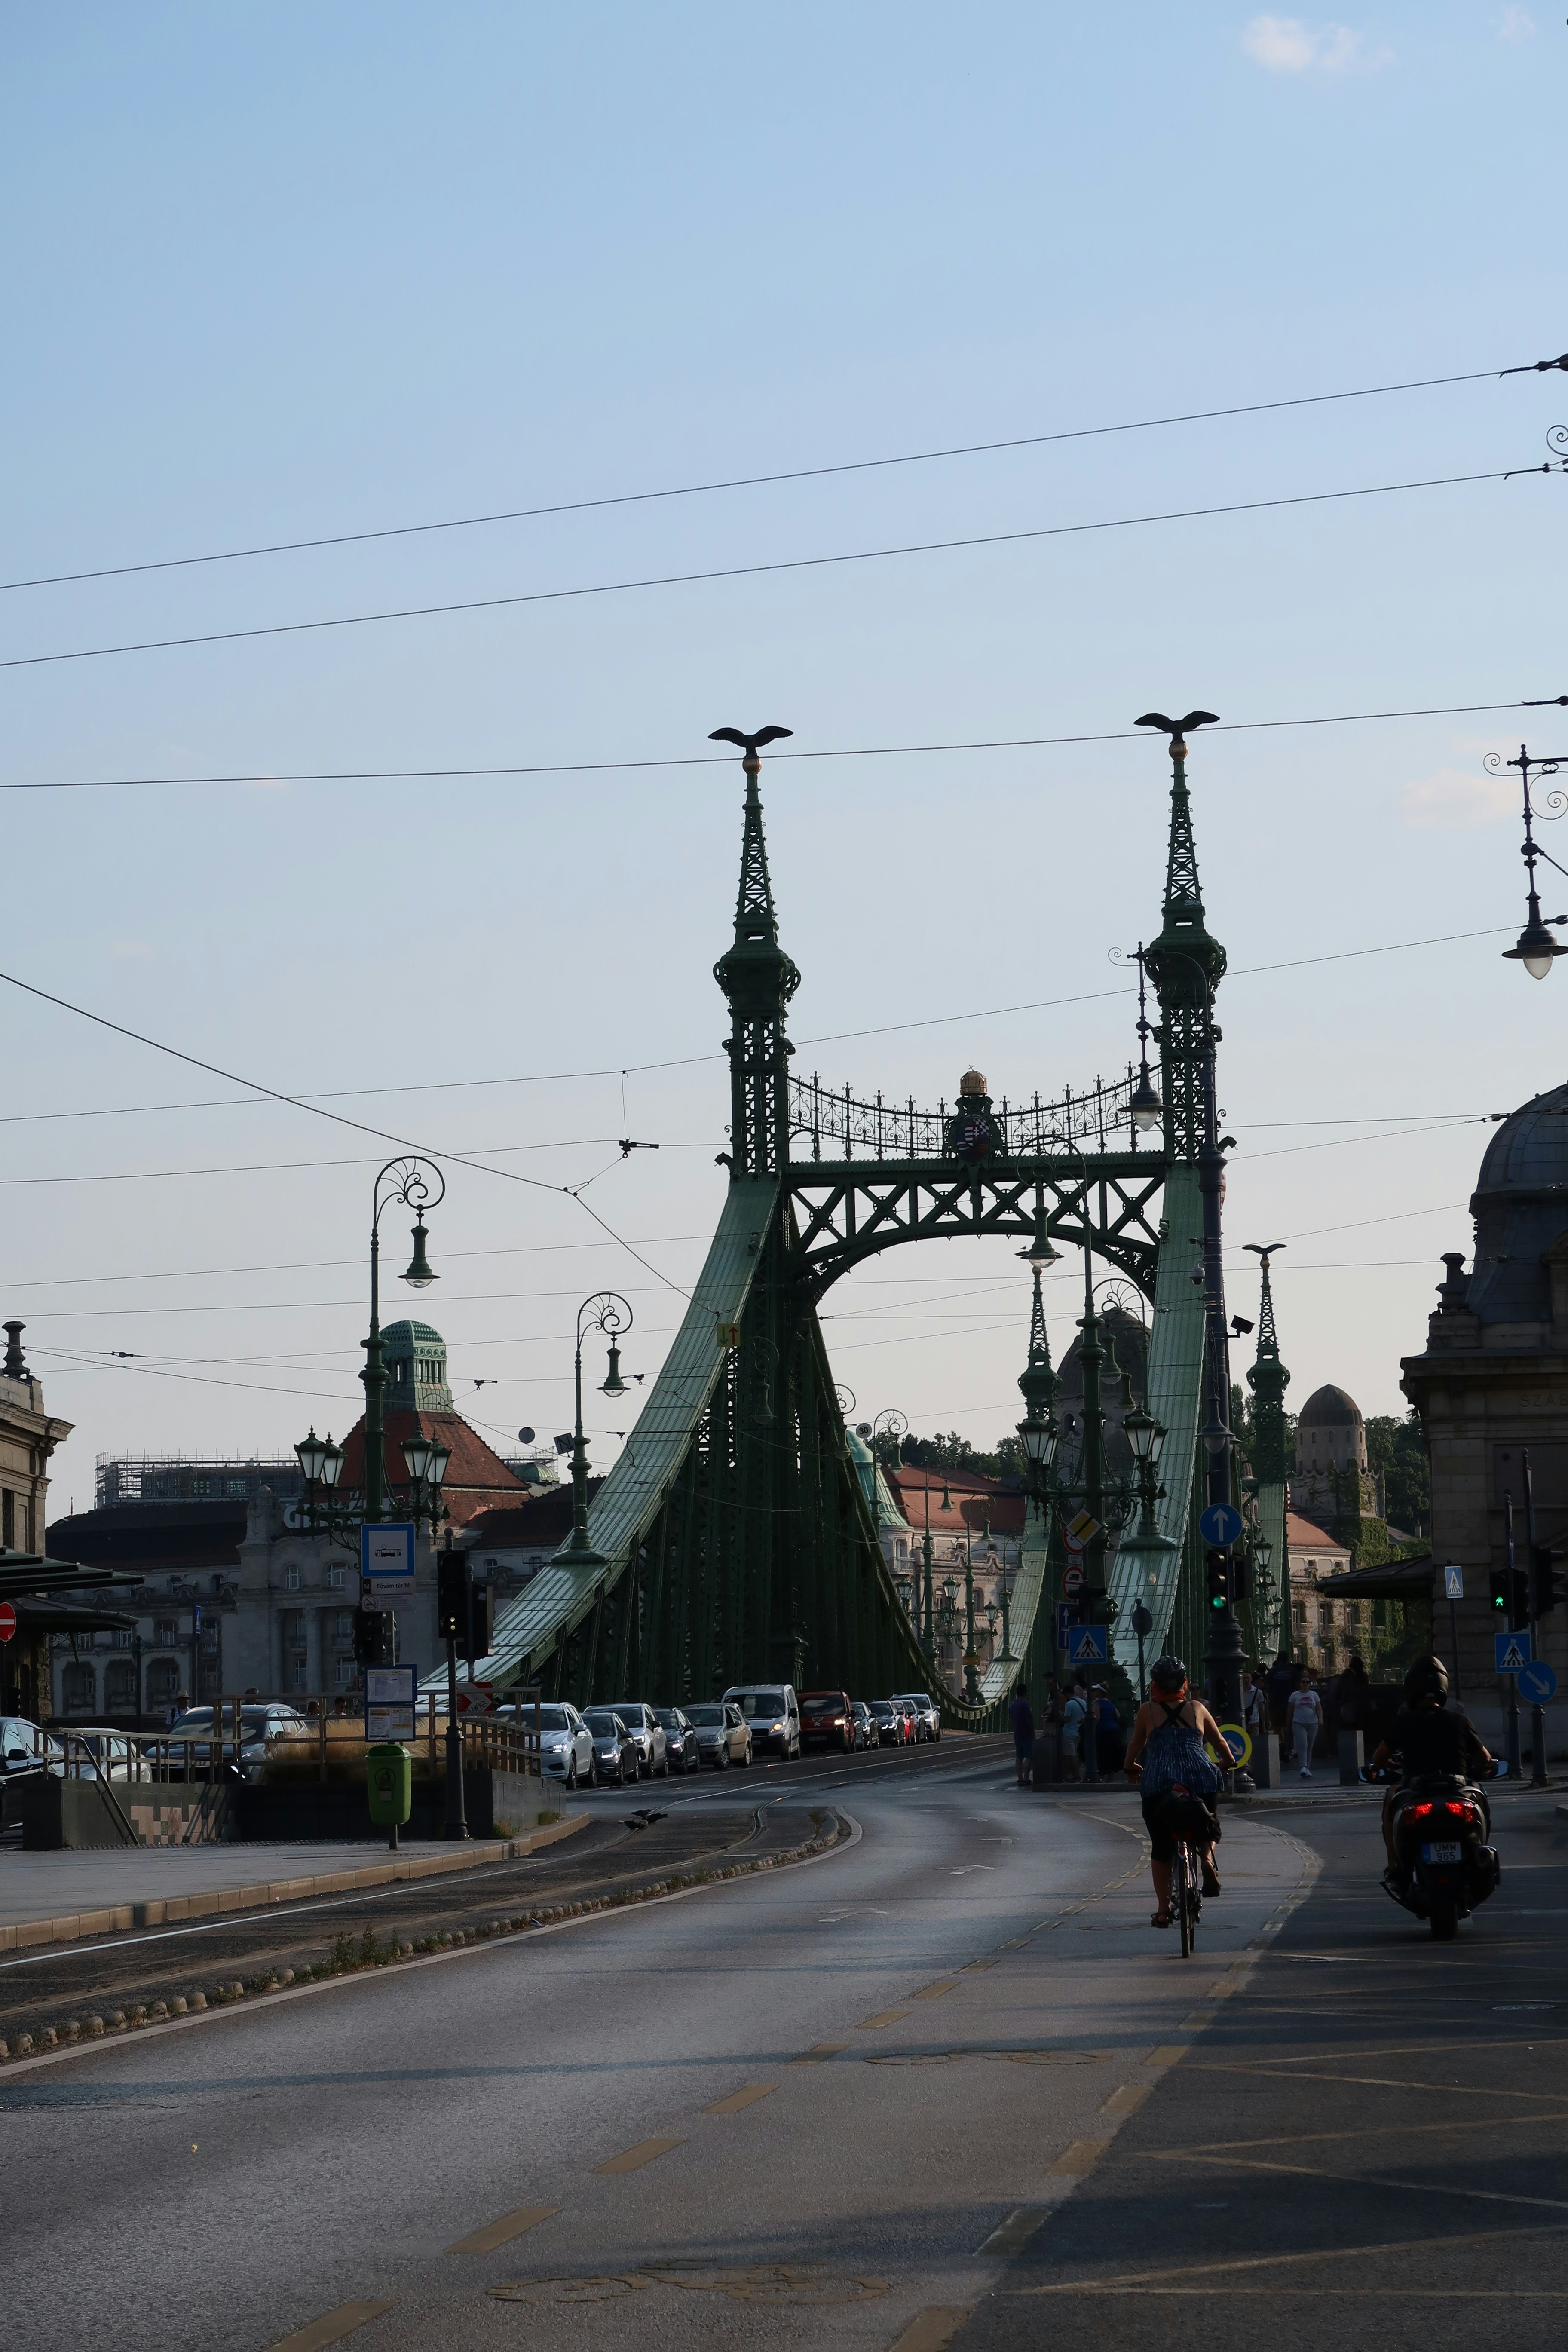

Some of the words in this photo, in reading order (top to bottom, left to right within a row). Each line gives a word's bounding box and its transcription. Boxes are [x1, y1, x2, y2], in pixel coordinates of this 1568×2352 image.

[1521, 1394, 1568, 1407] SZAB
[1434, 1843, 1456, 1852] UMW
[1437, 1852, 1455, 1861] 965
